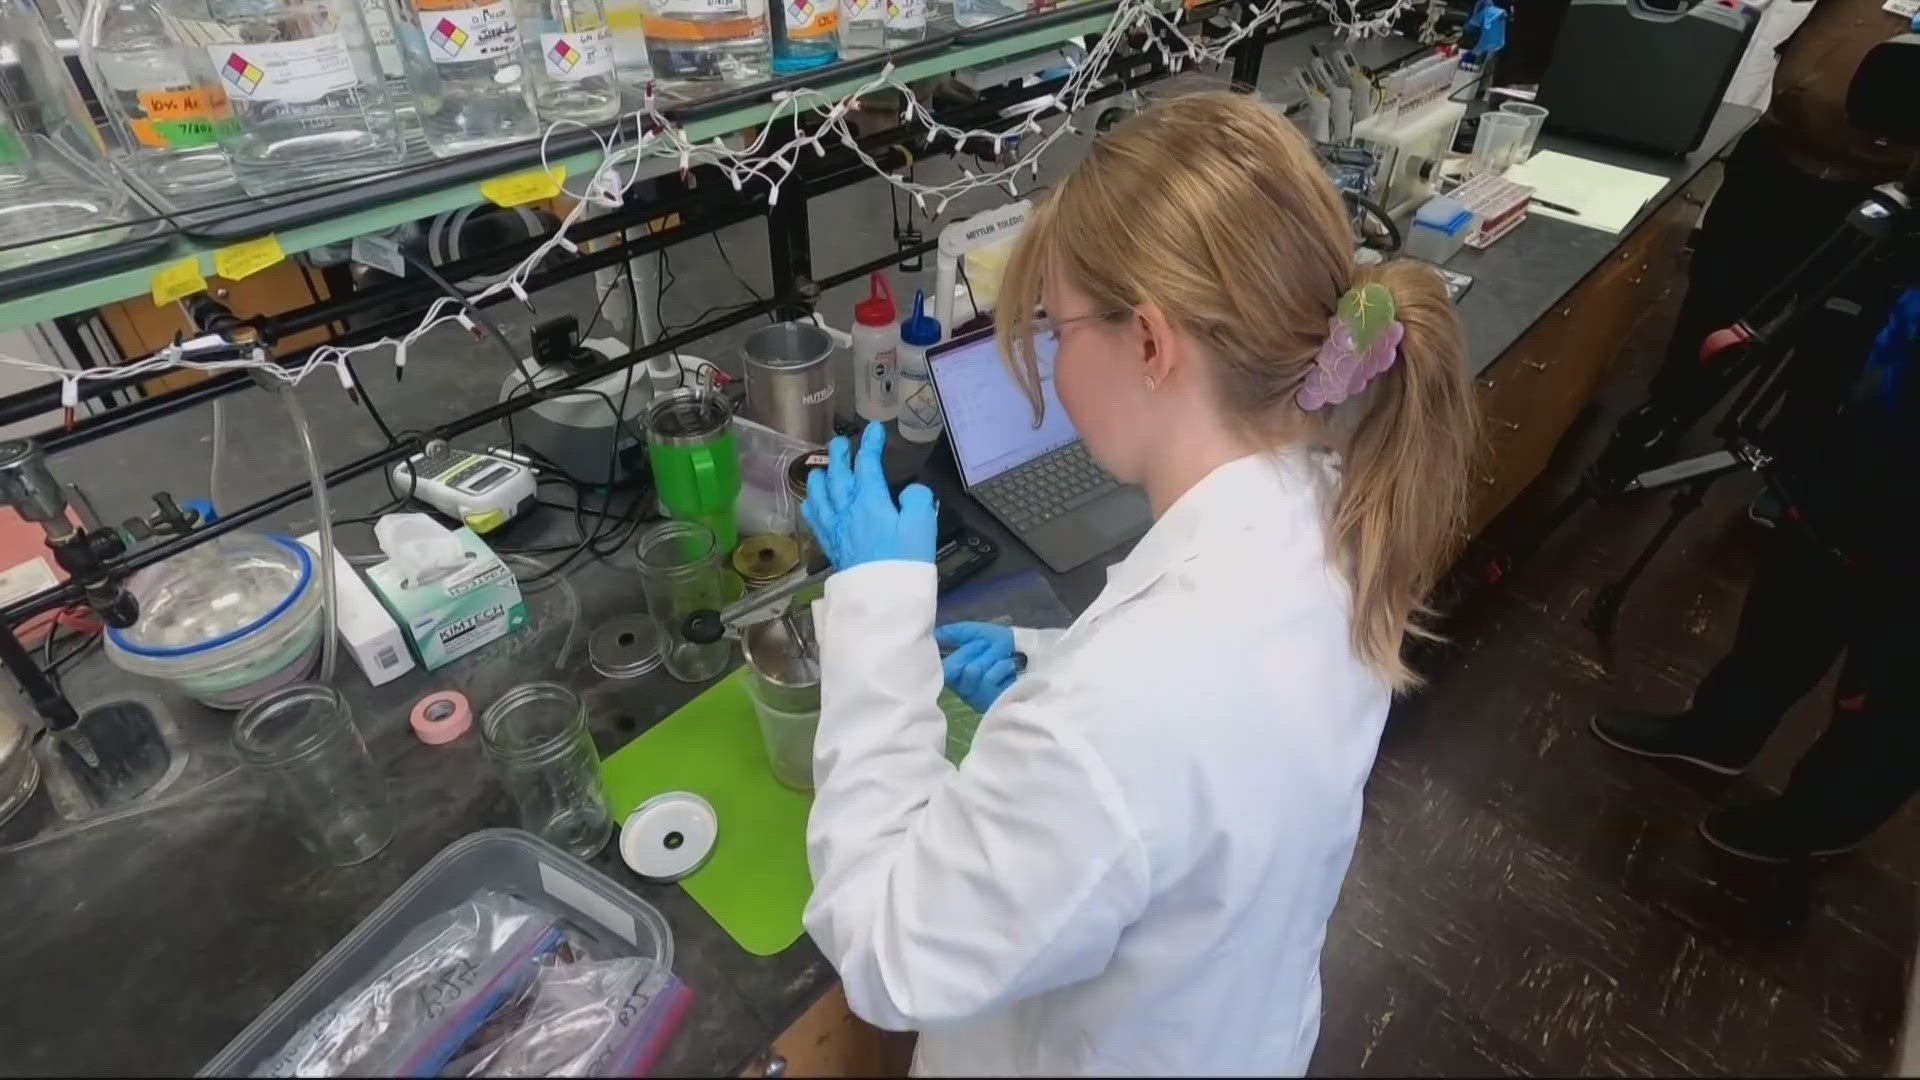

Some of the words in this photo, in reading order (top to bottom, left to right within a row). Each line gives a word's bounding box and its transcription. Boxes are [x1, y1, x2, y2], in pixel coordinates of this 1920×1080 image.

[966, 224, 995, 240] METTLER
[997, 214, 1024, 229] TOLEDO
[439, 603, 505, 640] KIMTECH
